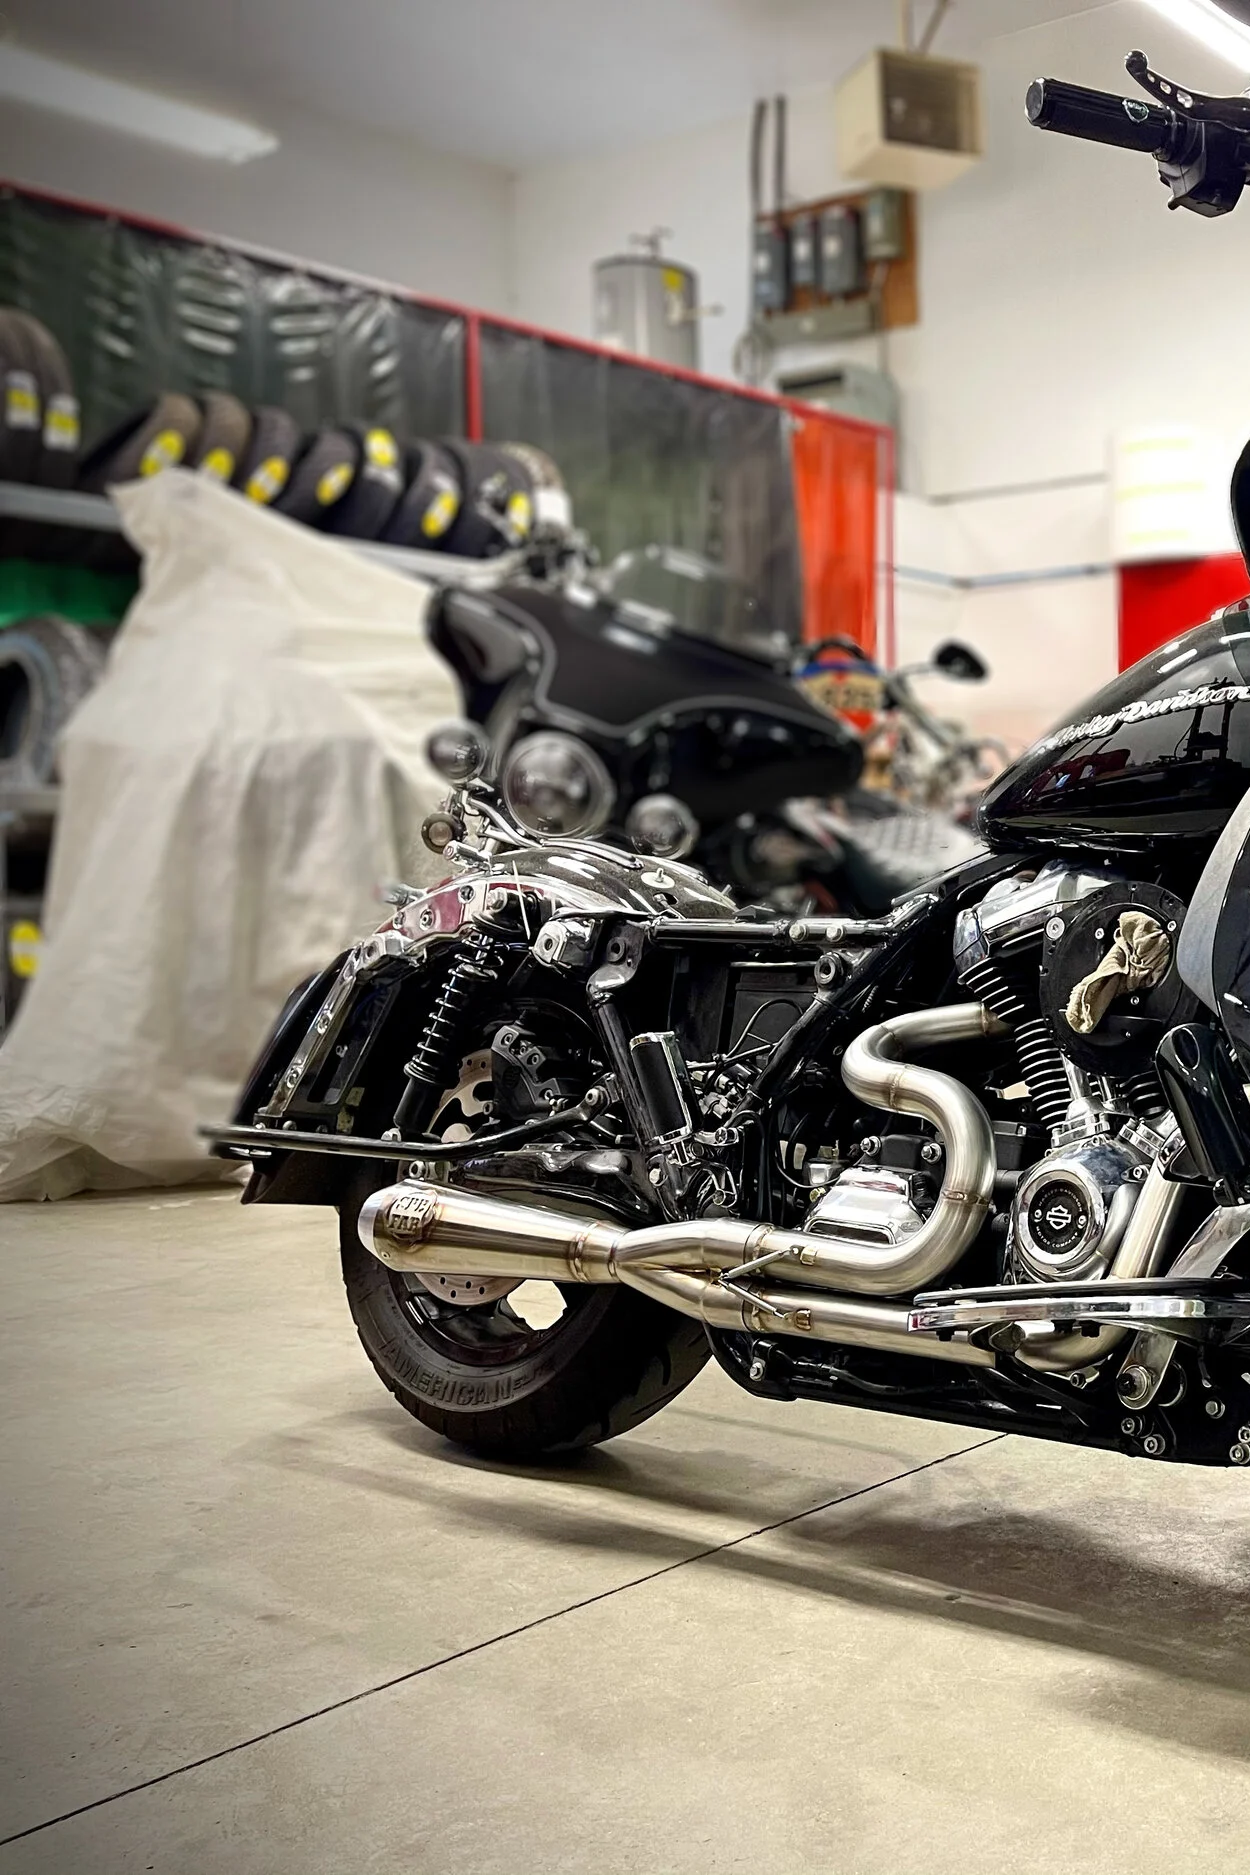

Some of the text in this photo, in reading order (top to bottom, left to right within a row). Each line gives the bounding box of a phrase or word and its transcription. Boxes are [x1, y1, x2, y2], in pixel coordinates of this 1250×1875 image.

[1036, 1226, 1079, 1248] MOTOR COMPANY
[381, 1341, 512, 1406] AMERICAN
